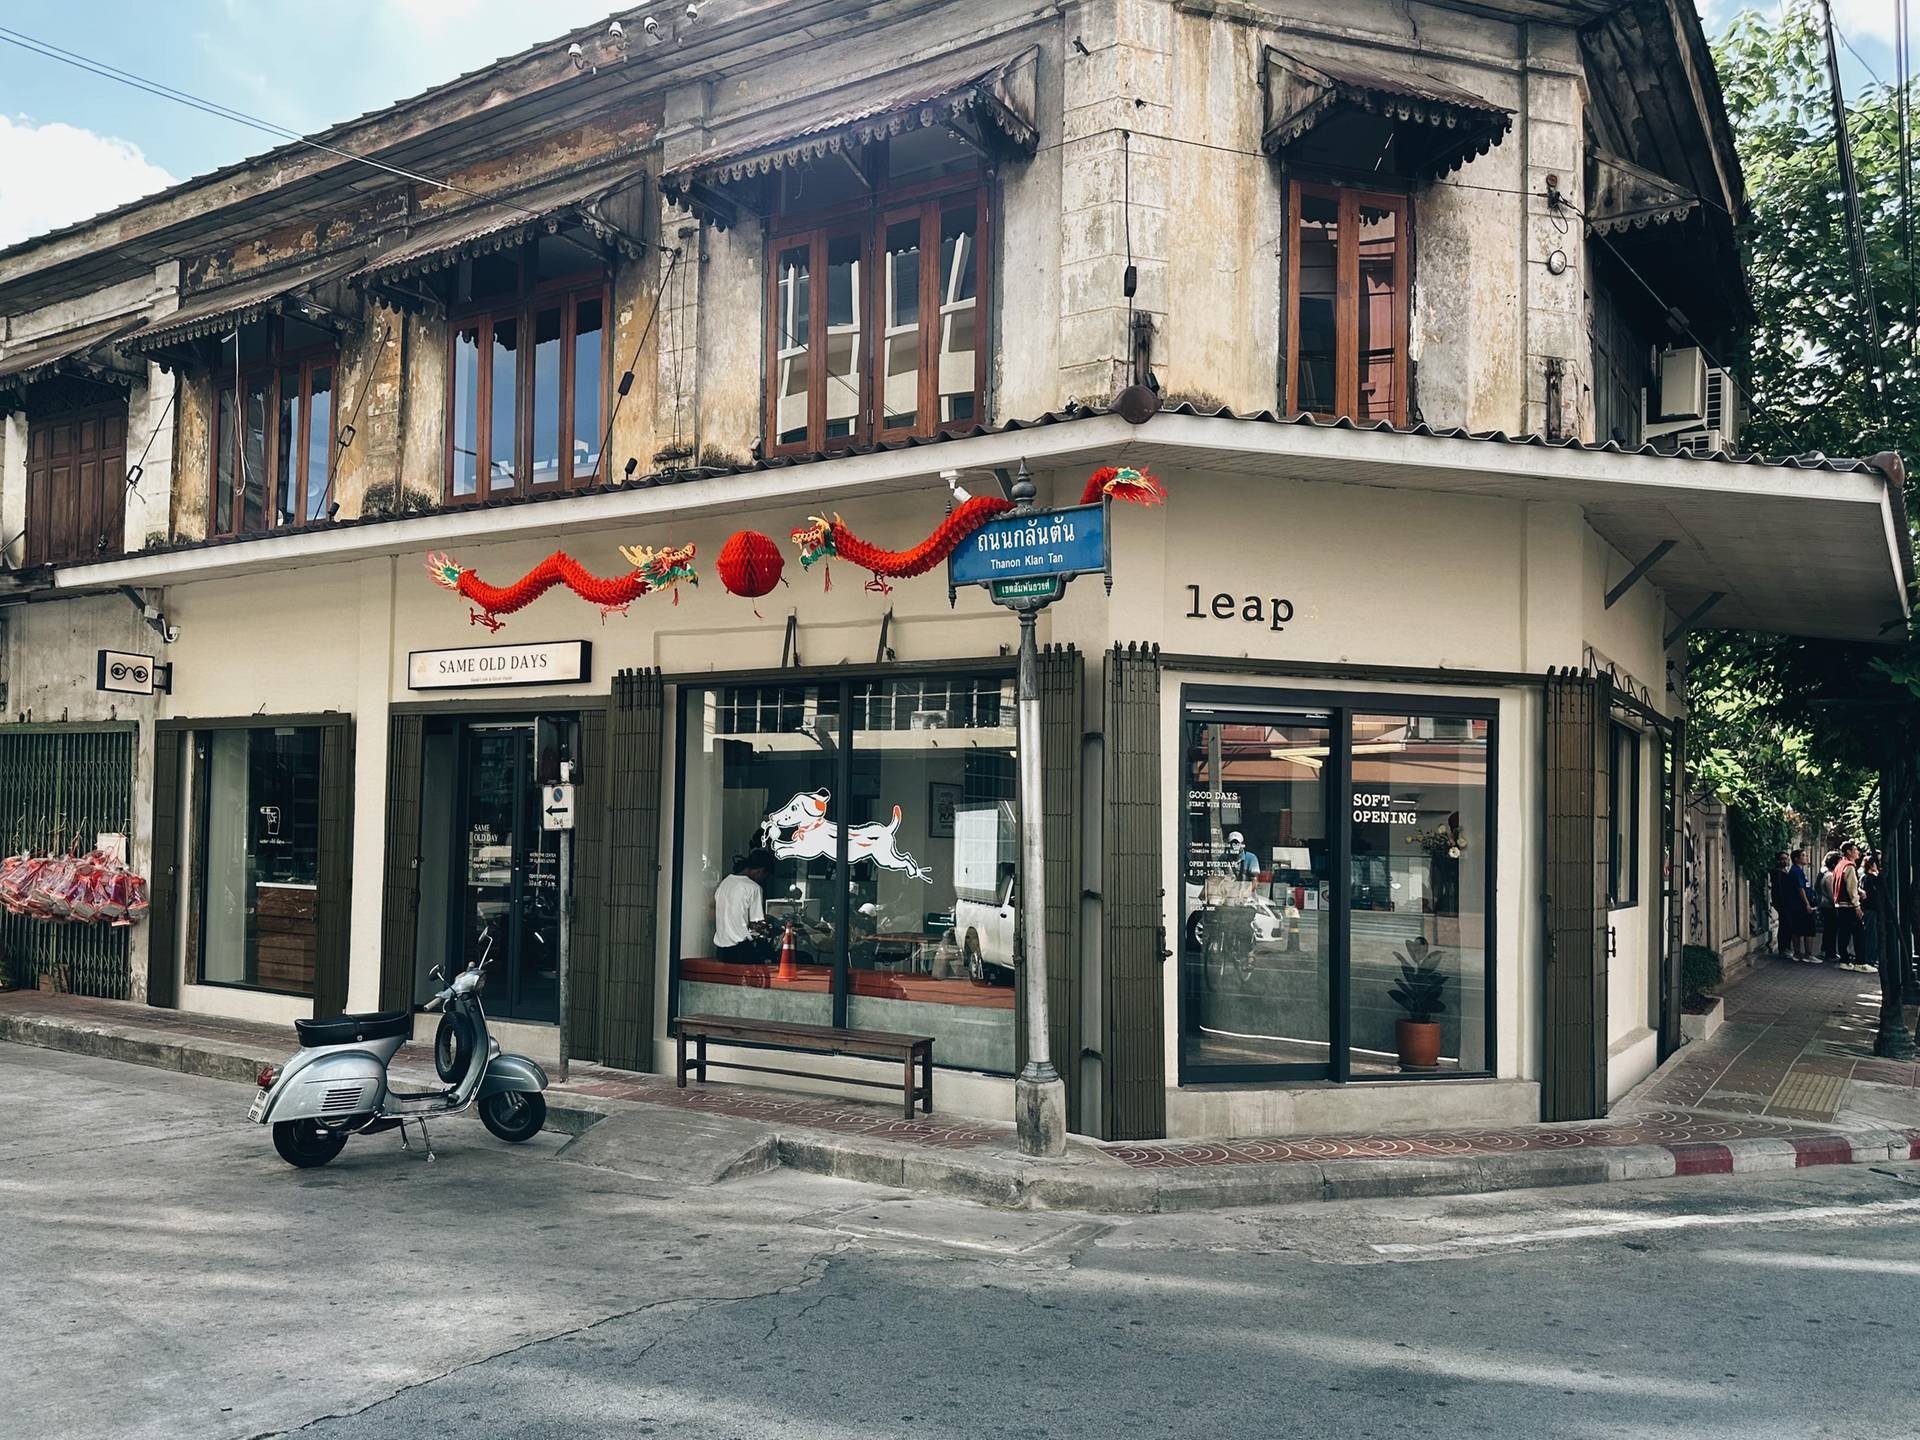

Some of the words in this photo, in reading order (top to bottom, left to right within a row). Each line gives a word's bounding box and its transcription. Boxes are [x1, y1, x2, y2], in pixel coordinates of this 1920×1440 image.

[977, 516, 1075, 551] ถนนกลันตัน
[991, 558, 1021, 570] Thanon
[1025, 556, 1044, 568] Klan
[1048, 552, 1064, 564] Tan
[1185, 584, 1294, 631] leap
[439, 658, 475, 674] SAME
[479, 656, 506, 672] OLD
[510, 653, 548, 670] DAYS
[1189, 790, 1212, 799] GOOD
[1215, 791, 1238, 800] DAYS
[1353, 793, 1391, 807] SOFT
[1353, 810, 1417, 825] OPENING
[474, 823, 490, 832] SAME
[473, 833, 486, 842] OLD
